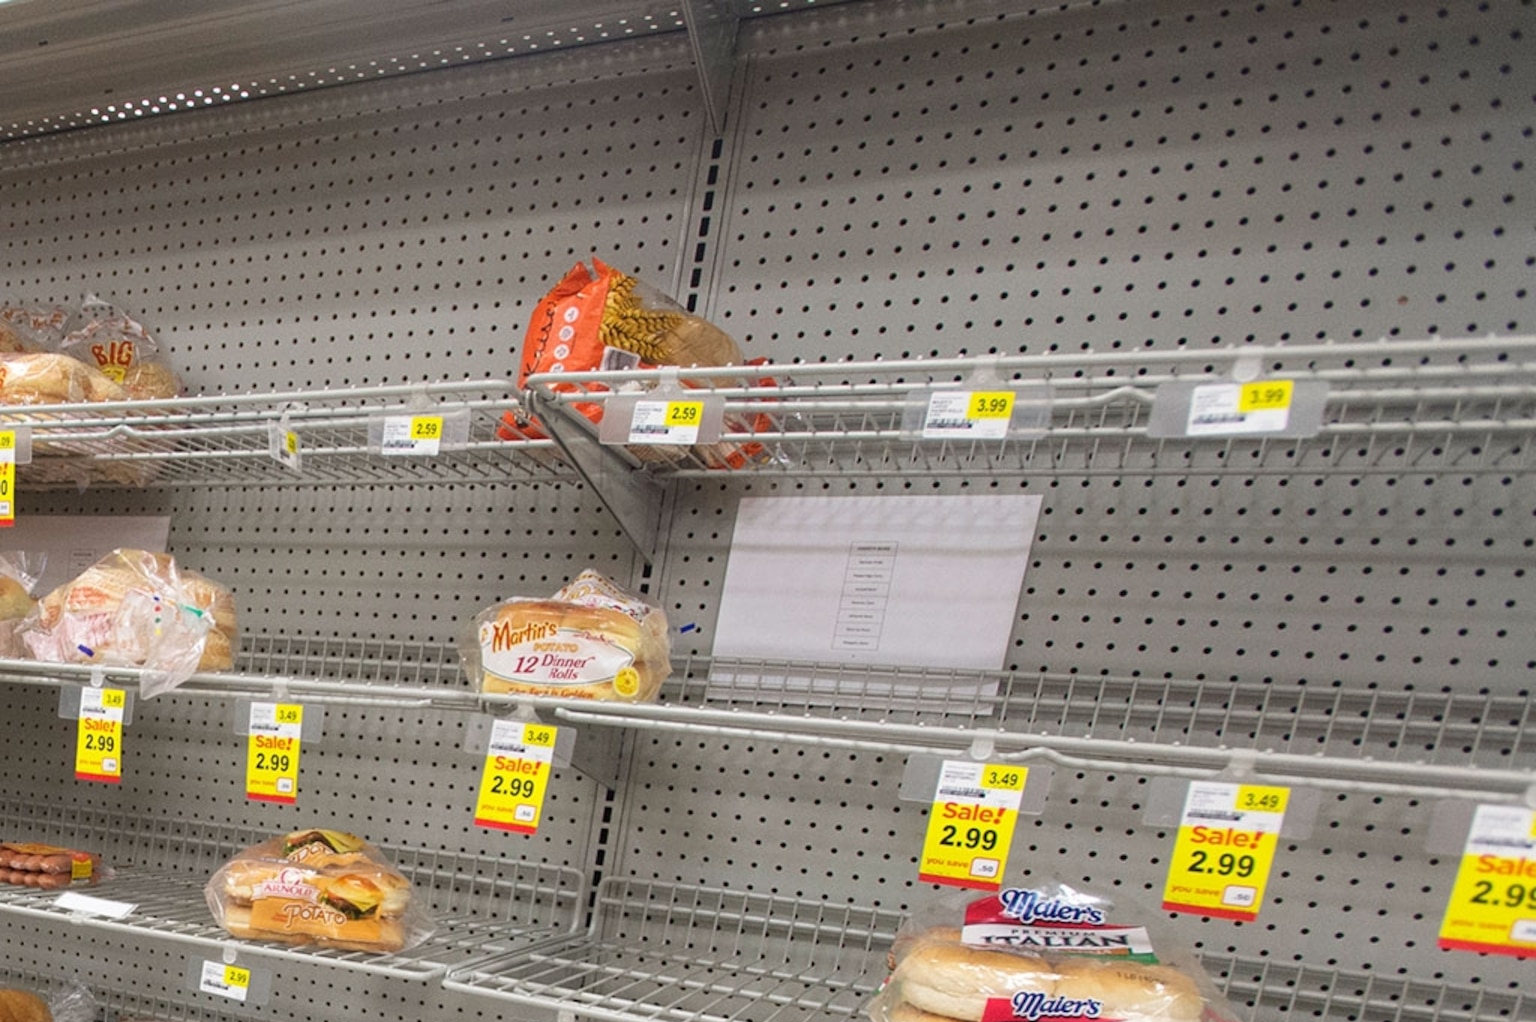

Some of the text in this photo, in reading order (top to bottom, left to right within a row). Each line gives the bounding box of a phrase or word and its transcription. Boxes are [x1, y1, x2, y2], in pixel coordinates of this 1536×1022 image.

[91, 340, 133, 367] BIG
[671, 406, 697, 420] 2.59
[977, 398, 1008, 412] 3.99
[416, 423, 438, 435] 2.59
[492, 621, 558, 652] Martin's
[533, 643, 579, 653] POTATO
[513, 656, 540, 673] 12
[541, 653, 595, 669] Dinner
[548, 667, 580, 680] Rolls
[279, 710, 298, 721] 3.49
[84, 717, 116, 733] Sale!
[85, 734, 115, 752] 2.99
[255, 735, 294, 751] Sale!
[527, 730, 550, 744] 3.49
[255, 753, 290, 772] 2.99
[494, 756, 542, 775] Sale!
[491, 776, 535, 799] 2.99
[988, 772, 1019, 787] 3.49
[1244, 793, 1280, 808] 3.49
[942, 802, 1007, 825] Sale!
[939, 825, 998, 851] 2.99
[1190, 826, 1265, 850] Sale!
[926, 857, 969, 869] you save
[1188, 850, 1256, 878] 2.99
[1170, 885, 1221, 897] you save
[1002, 889, 1104, 923] Maier's
[283, 904, 346, 929] POTATO
[981, 934, 1129, 948] ITALIAN
[1011, 929, 1097, 937] PREMIUM
[1013, 991, 1101, 1018] Maier's
